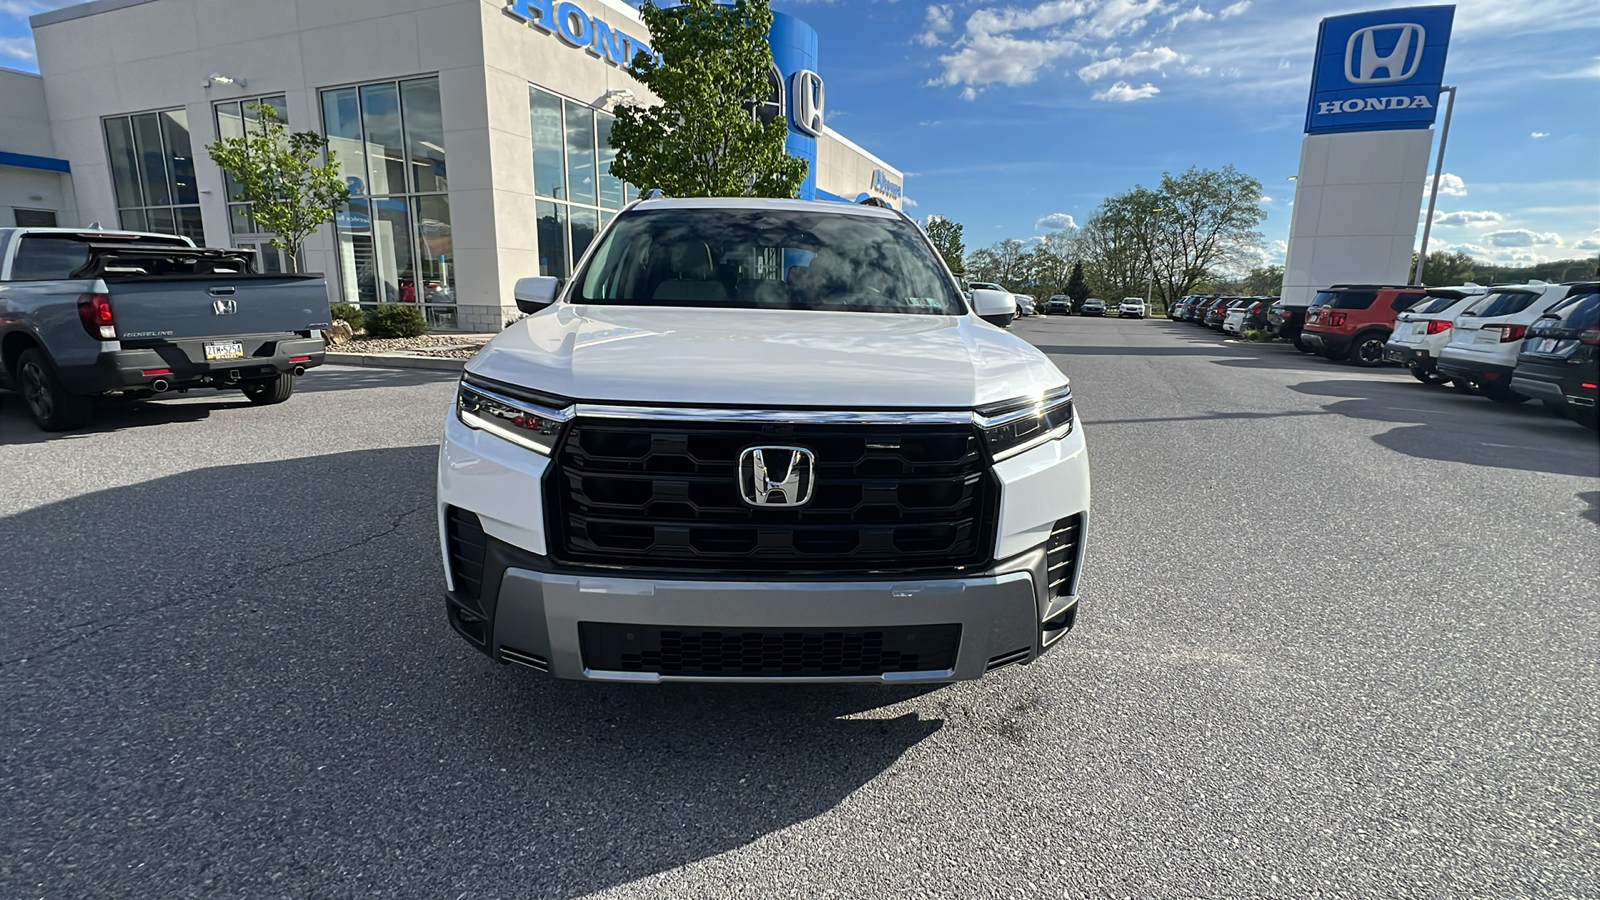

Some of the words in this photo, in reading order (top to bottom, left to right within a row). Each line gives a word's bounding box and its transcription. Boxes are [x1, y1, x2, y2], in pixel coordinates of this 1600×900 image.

[505, 0, 665, 74] HOND
[1317, 95, 1433, 115] HONDA
[123, 330, 173, 338] RIDGELINE
